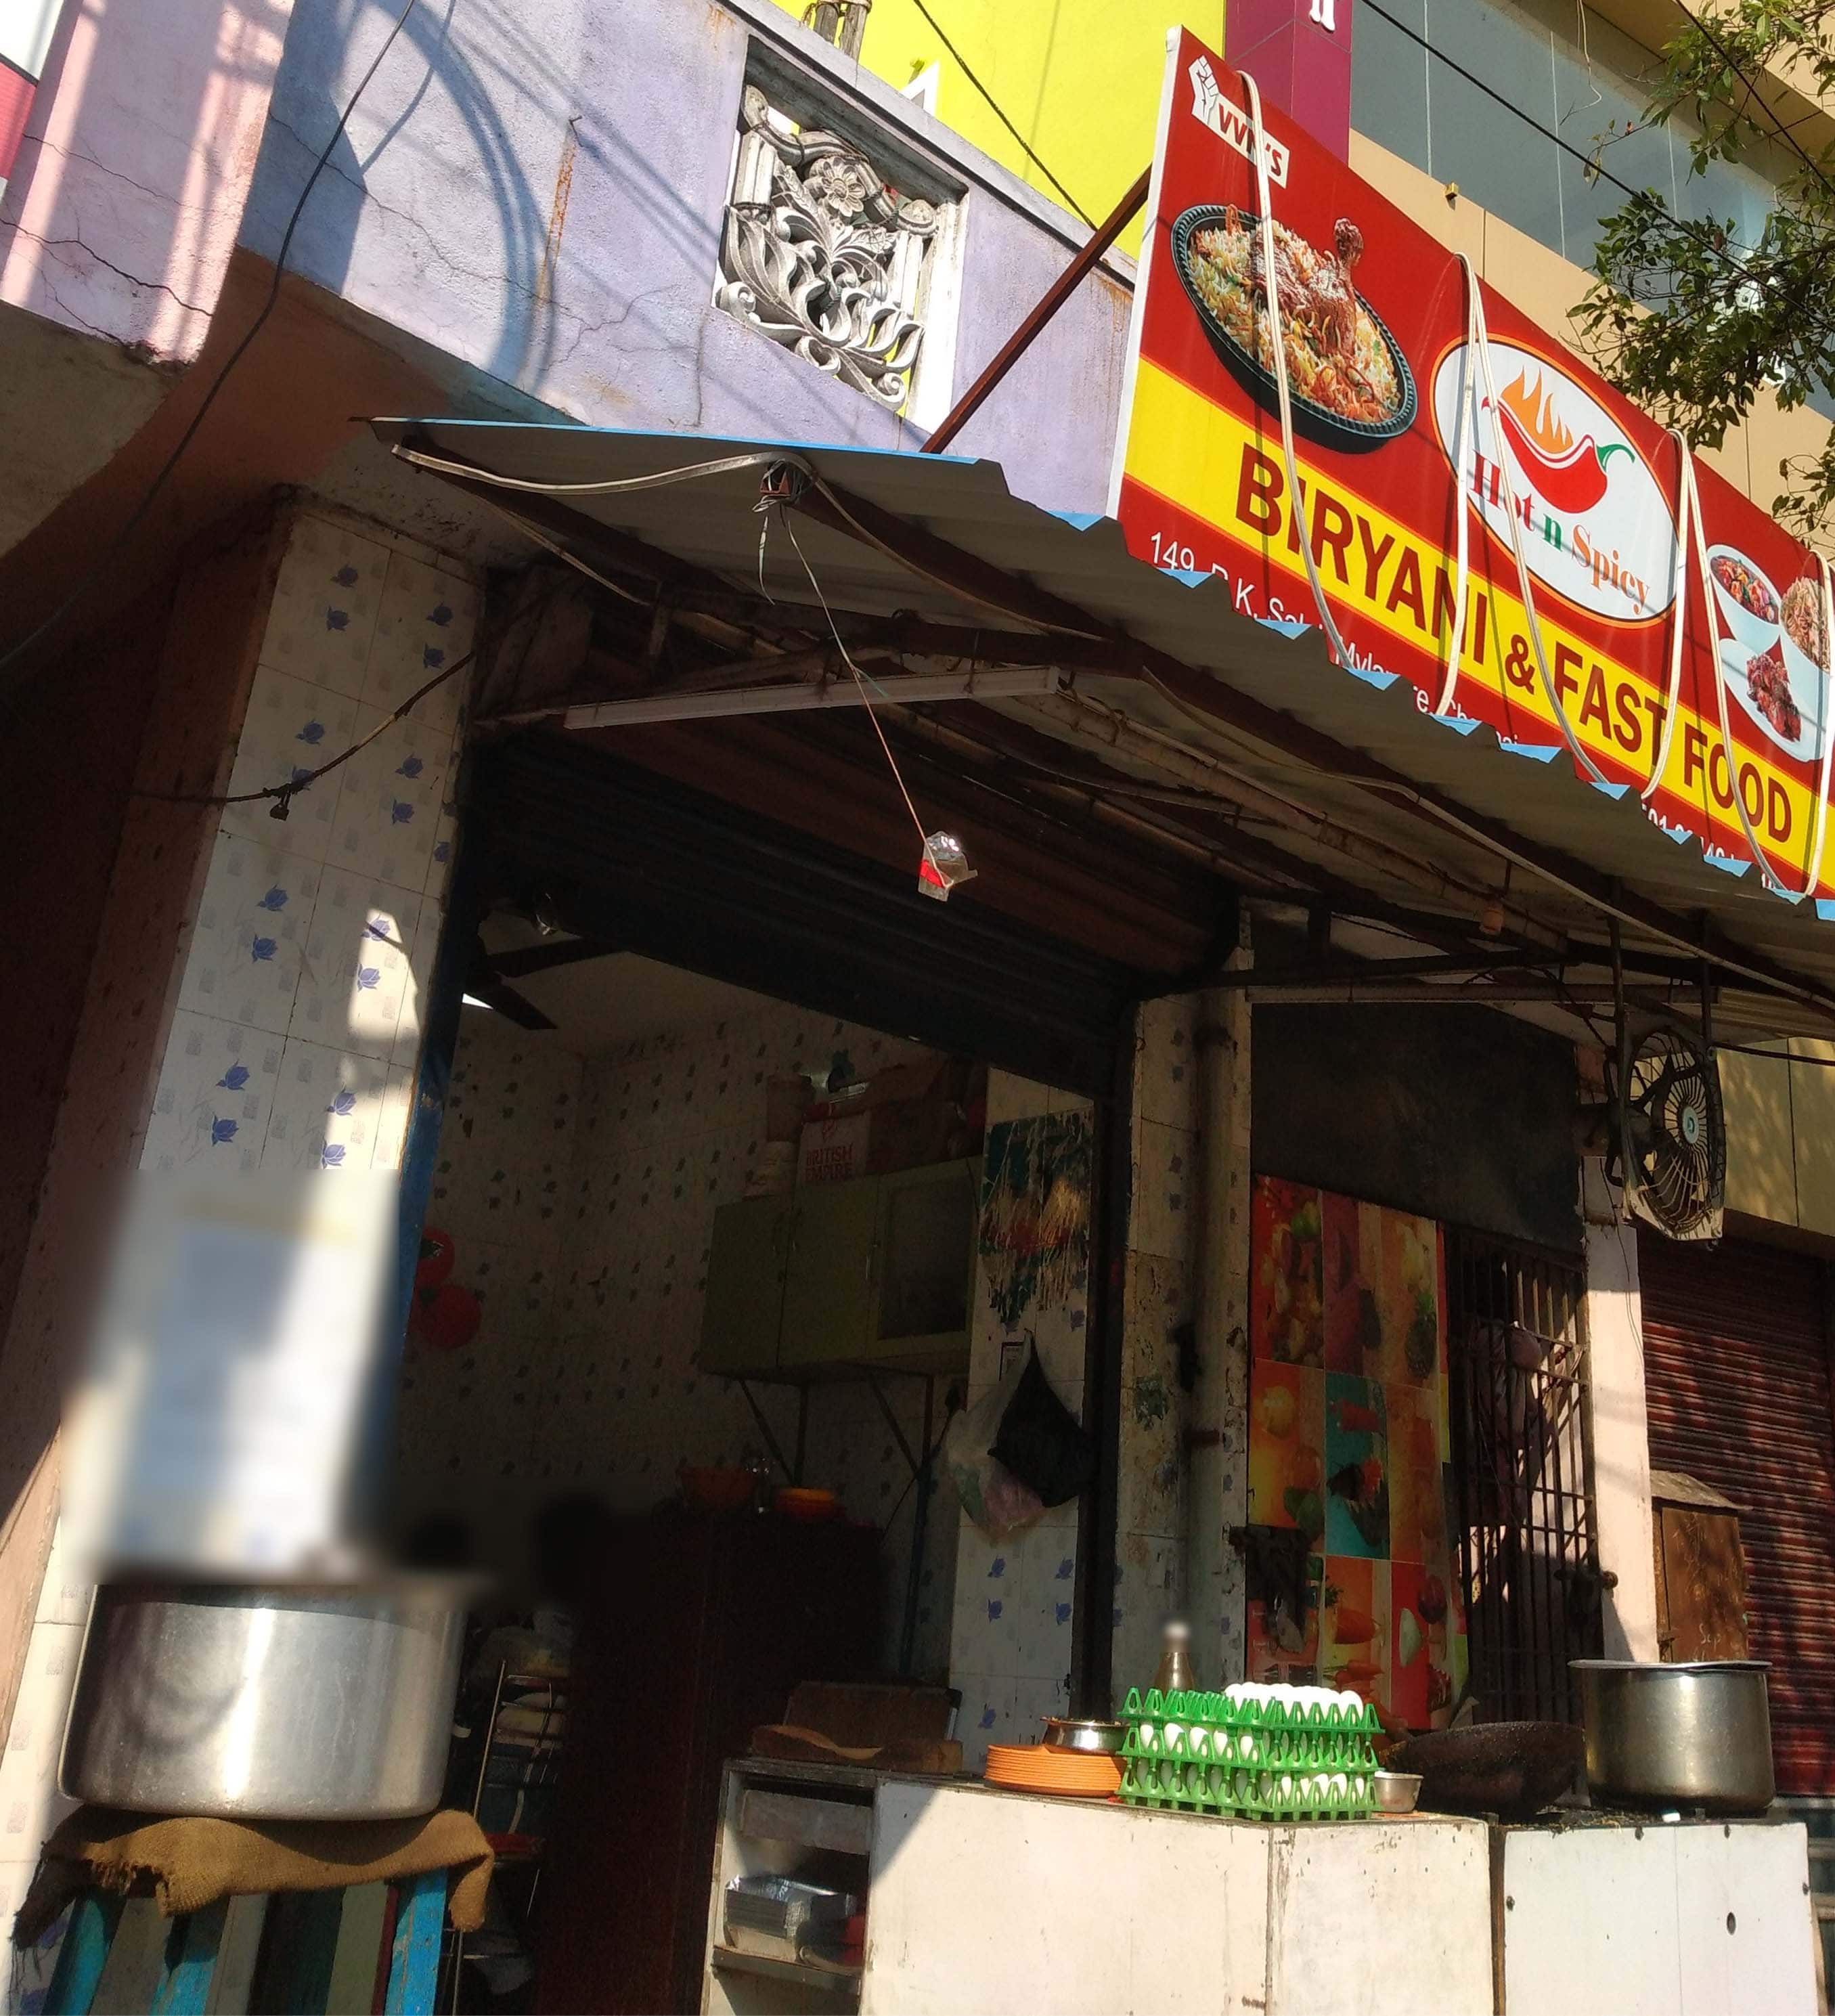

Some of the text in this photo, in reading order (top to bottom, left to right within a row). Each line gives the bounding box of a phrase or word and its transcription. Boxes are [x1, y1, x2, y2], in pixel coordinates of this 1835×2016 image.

[1472, 449, 1650, 615] Hot n Spicy
[1235, 442, 1488, 665] BIRYANI
[1505, 634, 1535, 695] &
[1553, 642, 1668, 775] FAST
[1683, 725, 1792, 843] FOOD
[806, 1142, 853, 1167] BRITISH
